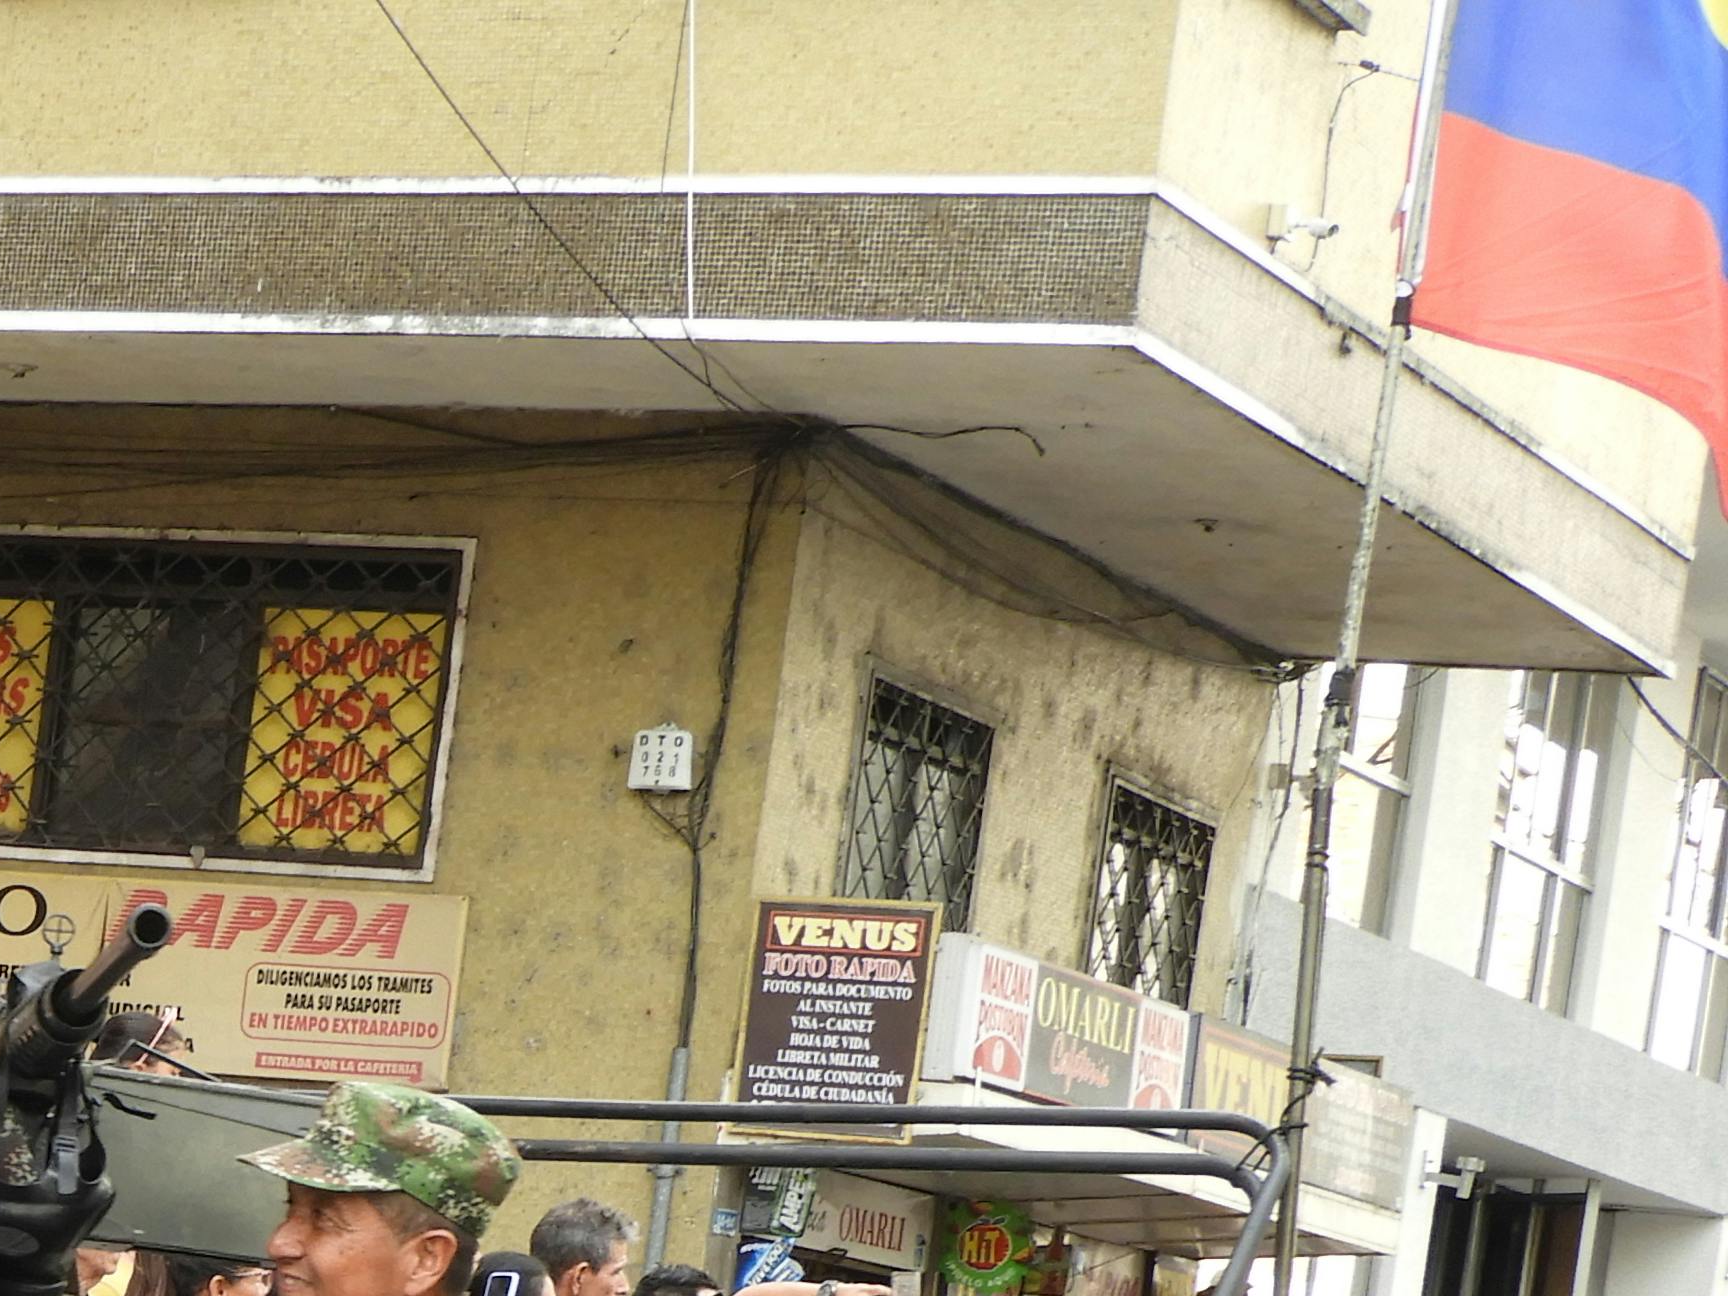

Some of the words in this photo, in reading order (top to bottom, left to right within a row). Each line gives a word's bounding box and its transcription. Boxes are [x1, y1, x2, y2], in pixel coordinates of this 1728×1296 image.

[271, 636, 433, 680] PASAPORTE
[294, 689, 393, 731] VISA
[283, 740, 389, 783] CEDULA
[275, 789, 385, 832] LIBRETA
[774, 916, 918, 952] VENUS
[762, 952, 827, 980] FOTO
[828, 956, 917, 984] RAPIDA
[256, 969, 348, 990] DILIGENCIAMOS
[350, 975, 374, 991] LOS
[376, 976, 434, 995] TRAMITES
[762, 979, 803, 994] FOTOS
[803, 981, 835, 997] PARA
[835, 984, 913, 1001] DOCUMENTO
[284, 993, 314, 1010] PARA
[317, 995, 333, 1011] SU
[335, 996, 402, 1015] PASAPORTE
[796, 999, 814, 1013] AL
[814, 1000, 875, 1016] INSTANTE
[1037, 977, 1137, 1055] OMARLI
[248, 1012, 269, 1029] EN
[272, 1013, 330, 1034] TIEMPO
[332, 1018, 439, 1040] EXTRARAPIDO
[789, 1033, 822, 1048] HOJA
[823, 1035, 841, 1049] DE
[842, 1036, 871, 1051] VIDA
[260, 1055, 313, 1070] ENTRADA
[314, 1059, 339, 1072] POR
[340, 1061, 355, 1073] LA
[356, 1063, 419, 1076] CAFETERIA
[776, 1049, 828, 1066] LIBRETA
[828, 1052, 881, 1069] MILITAR
[748, 1064, 806, 1082] LICENCIA
[806, 1068, 823, 1083] DE
[802, 1084, 820, 1099] DE
[839, 1204, 906, 1252] OMARLI
